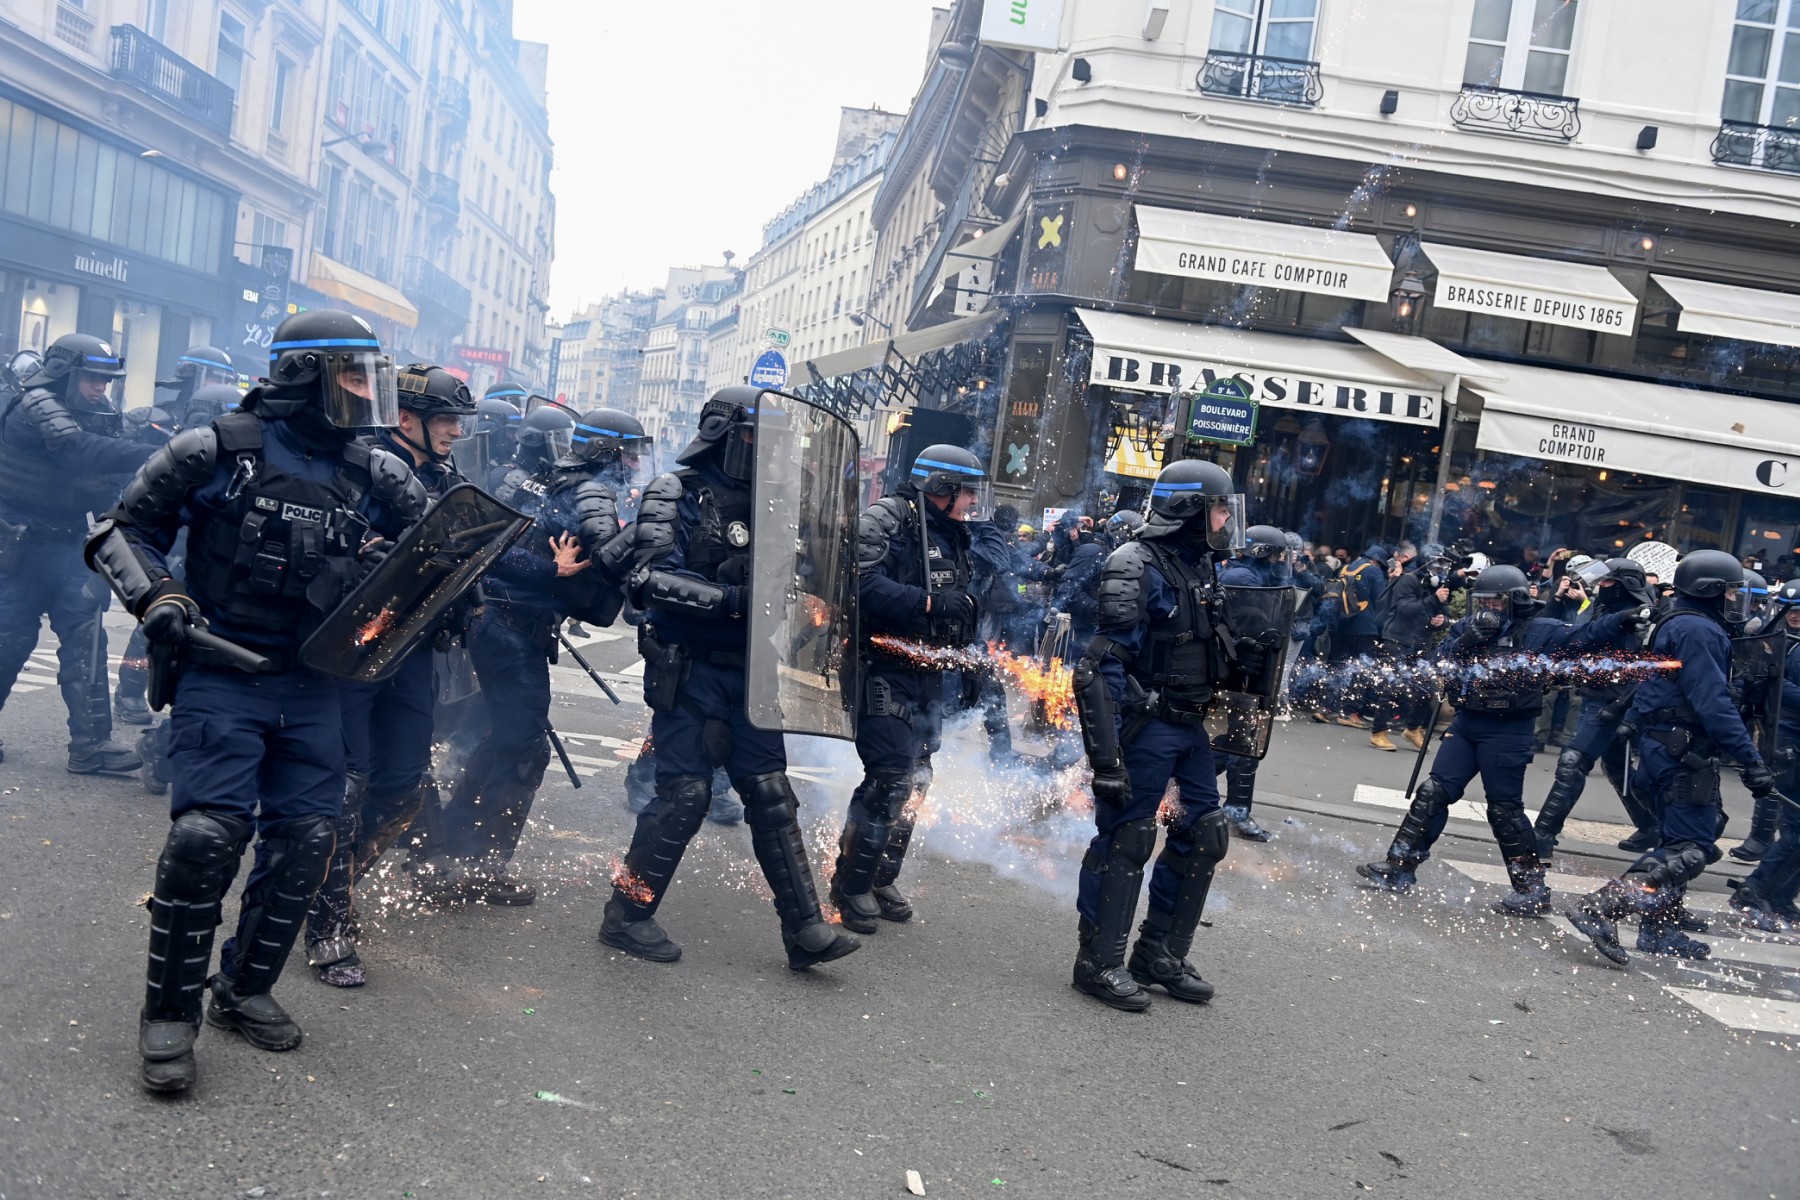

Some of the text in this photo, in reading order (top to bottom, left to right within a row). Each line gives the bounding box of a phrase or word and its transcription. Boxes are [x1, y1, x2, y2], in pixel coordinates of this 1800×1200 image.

[73, 251, 129, 283] minelli
[1178, 252, 1349, 289] GRAND CAFE COMPTOIR
[1447, 285, 1624, 327] BRASSERIE DEPUIS 1865
[460, 348, 504, 362] CHARTIER
[1105, 355, 1435, 421] BRASSERIE
[1200, 404, 1247, 419] BOULEVARD
[1192, 418, 1250, 435] POISSONNIÈRE
[1552, 424, 1596, 444] GRAND
[1538, 438, 1606, 463] COMPTOIR
[1755, 459, 1788, 488] C
[285, 505, 321, 521] POLIC
[930, 571, 952, 580] OLICE
